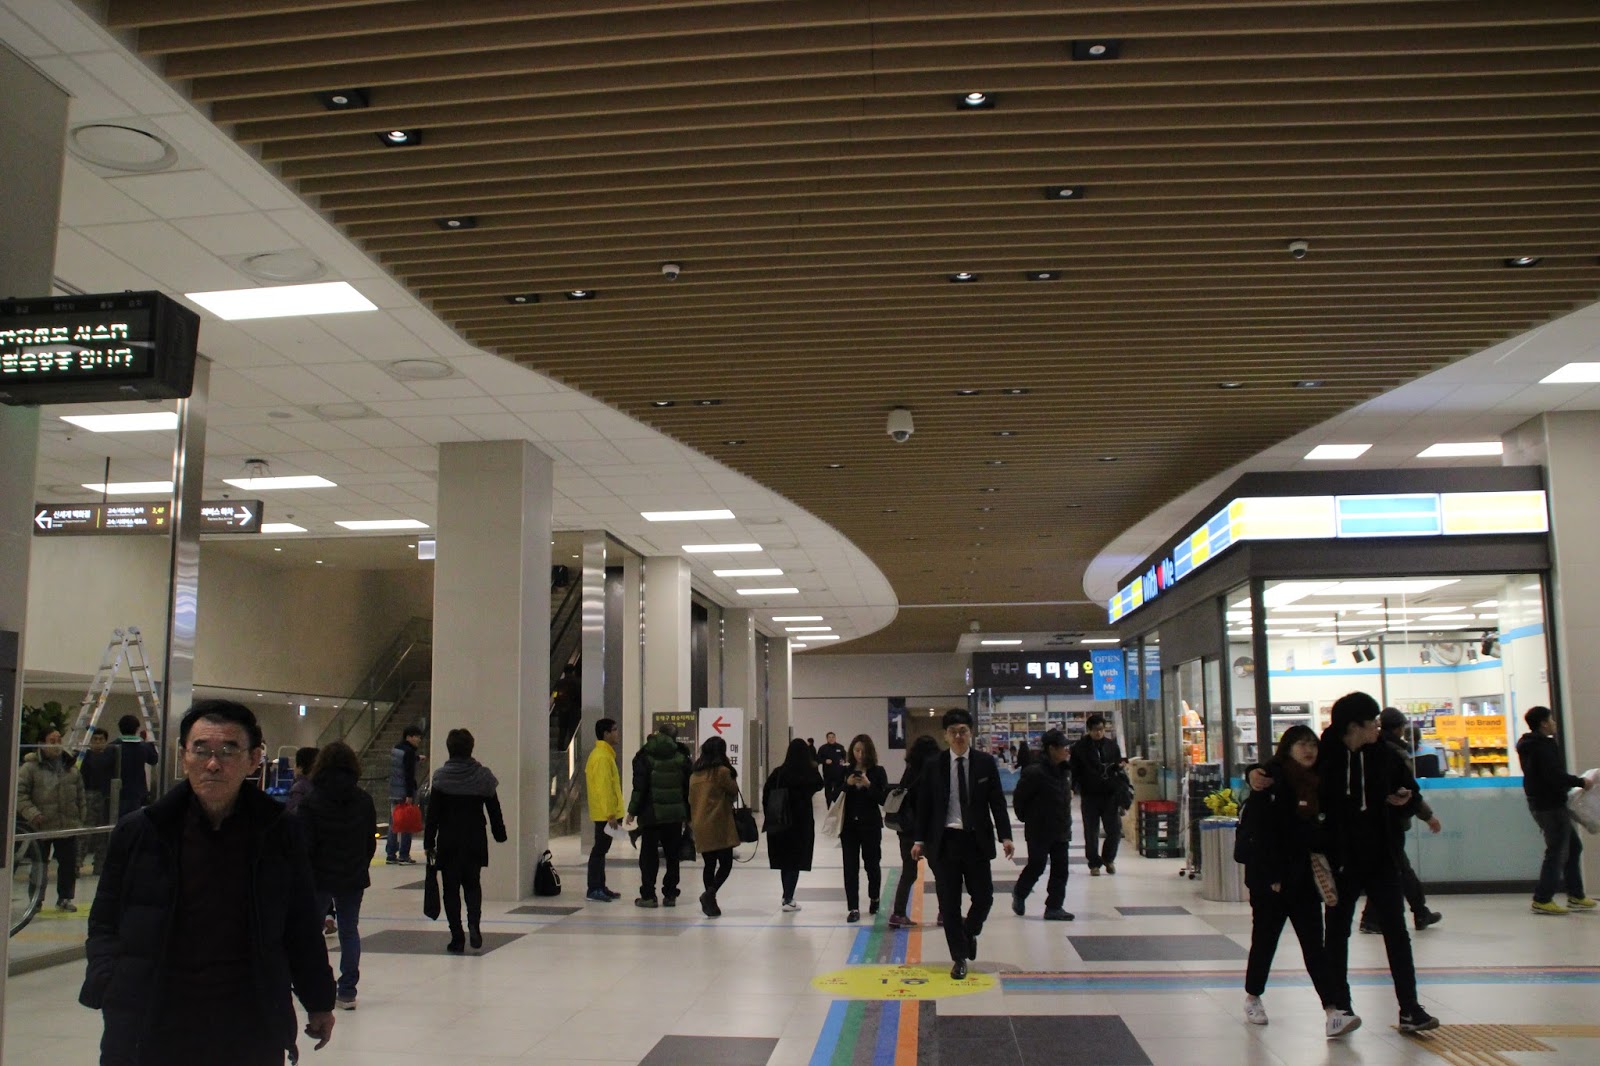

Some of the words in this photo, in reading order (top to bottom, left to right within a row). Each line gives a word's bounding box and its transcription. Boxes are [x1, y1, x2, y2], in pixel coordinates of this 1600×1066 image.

[1142, 564, 1159, 602] With
[1161, 557, 1175, 590] Me
[1094, 655, 1120, 663] OPEN
[1026, 661, 1079, 679] 터미널
[1099, 668, 1118, 677] With
[891, 713, 905, 740] 1
